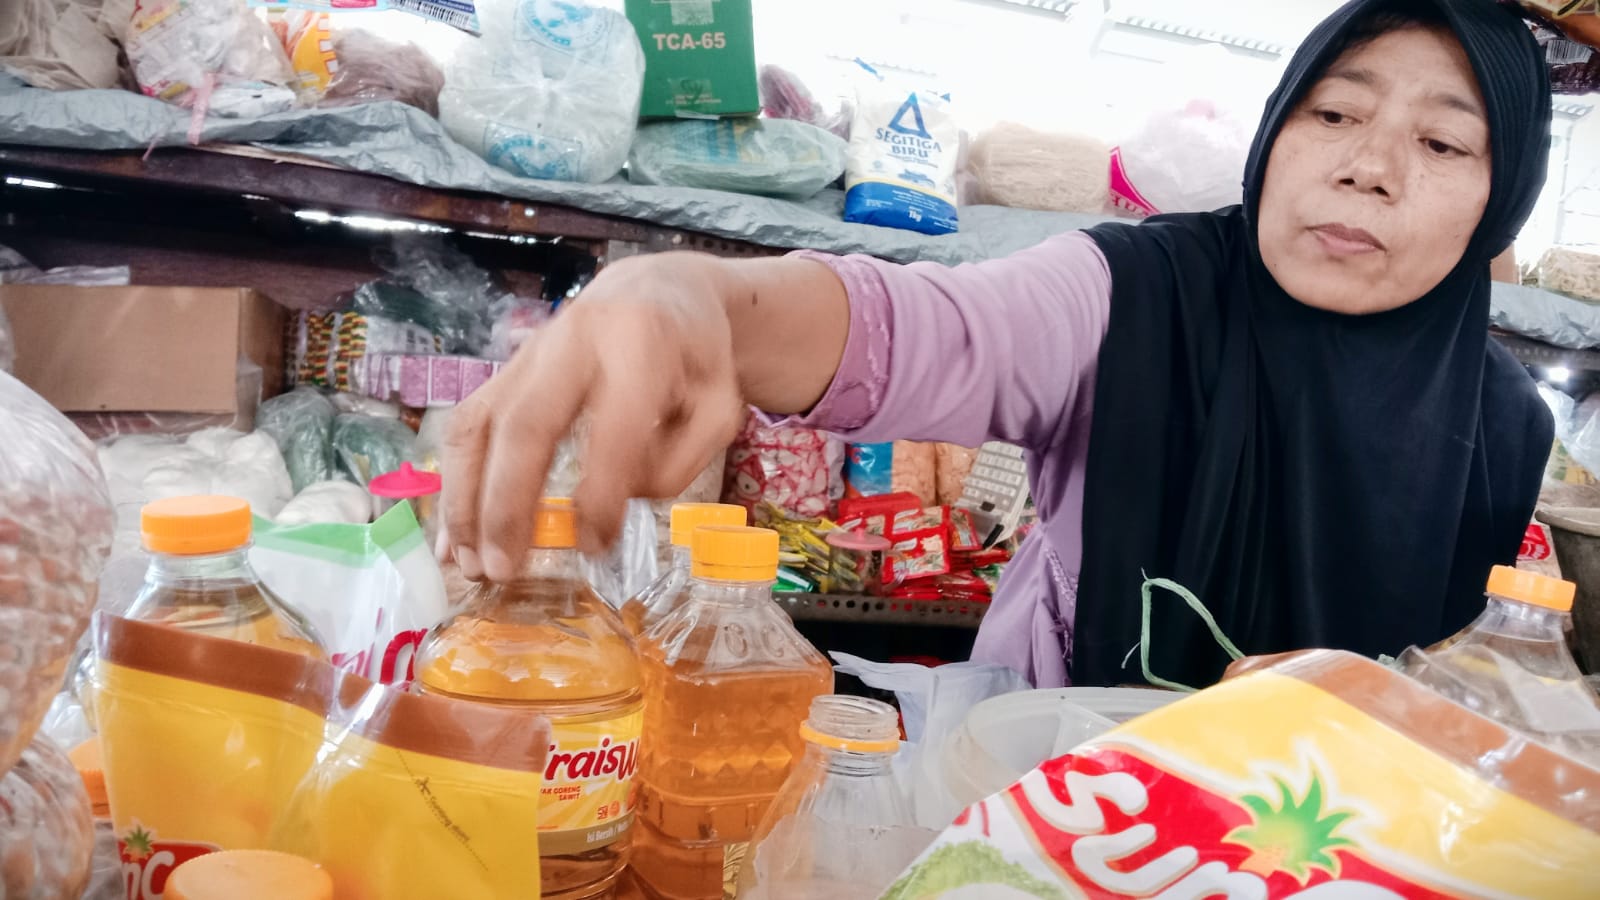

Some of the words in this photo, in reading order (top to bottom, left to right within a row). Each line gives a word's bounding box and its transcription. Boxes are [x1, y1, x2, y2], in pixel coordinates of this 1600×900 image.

[652, 31, 727, 51] TCA-65
[874, 127, 942, 153] SEGITIGA
[891, 144, 929, 158] BIRU
[544, 737, 640, 781] raisW
[1018, 770, 1410, 900] Sun
